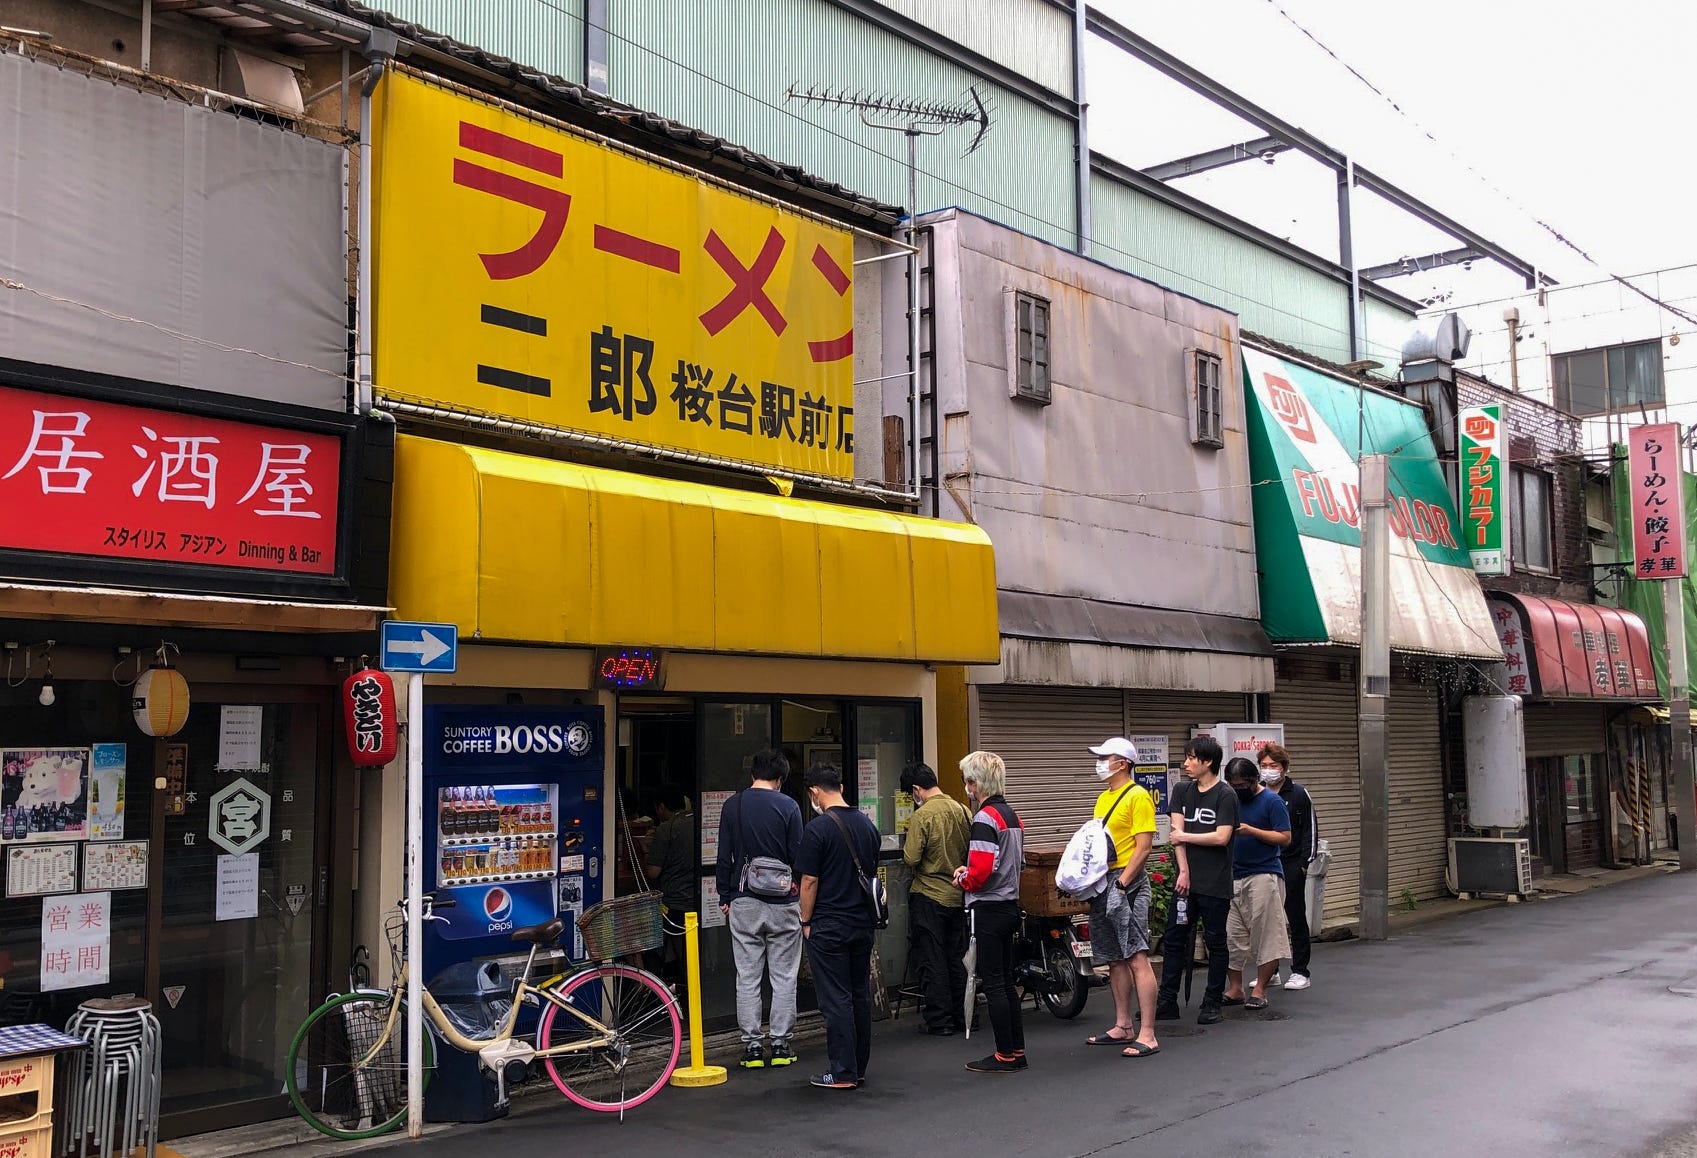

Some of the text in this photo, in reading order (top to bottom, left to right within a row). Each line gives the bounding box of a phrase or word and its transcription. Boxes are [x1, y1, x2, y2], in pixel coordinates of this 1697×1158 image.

[453, 120, 854, 363] ラーメン
[477, 303, 657, 421] 二郎
[1, 409, 322, 519] 居酒屋
[1292, 468, 1459, 550] FUJOLOR
[1468, 446, 1494, 546] フジカラー
[1644, 439, 1670, 553] らーめん・餃子
[104, 526, 322, 565] スタイリス アジアン Dinning & Bar
[1640, 556, 1677, 574] 孝華
[601, 656, 658, 680] OPEN
[1496, 607, 1529, 694] 中華料理
[351, 676, 384, 753] やきとり
[444, 726, 492, 738] SUNTORY
[443, 725, 563, 754] COFFEE BOSS
[46, 902, 103, 933] 営業
[488, 920, 513, 934] pepsi
[45, 945, 102, 975] 時間
[0, 1073, 26, 1089] Asah
